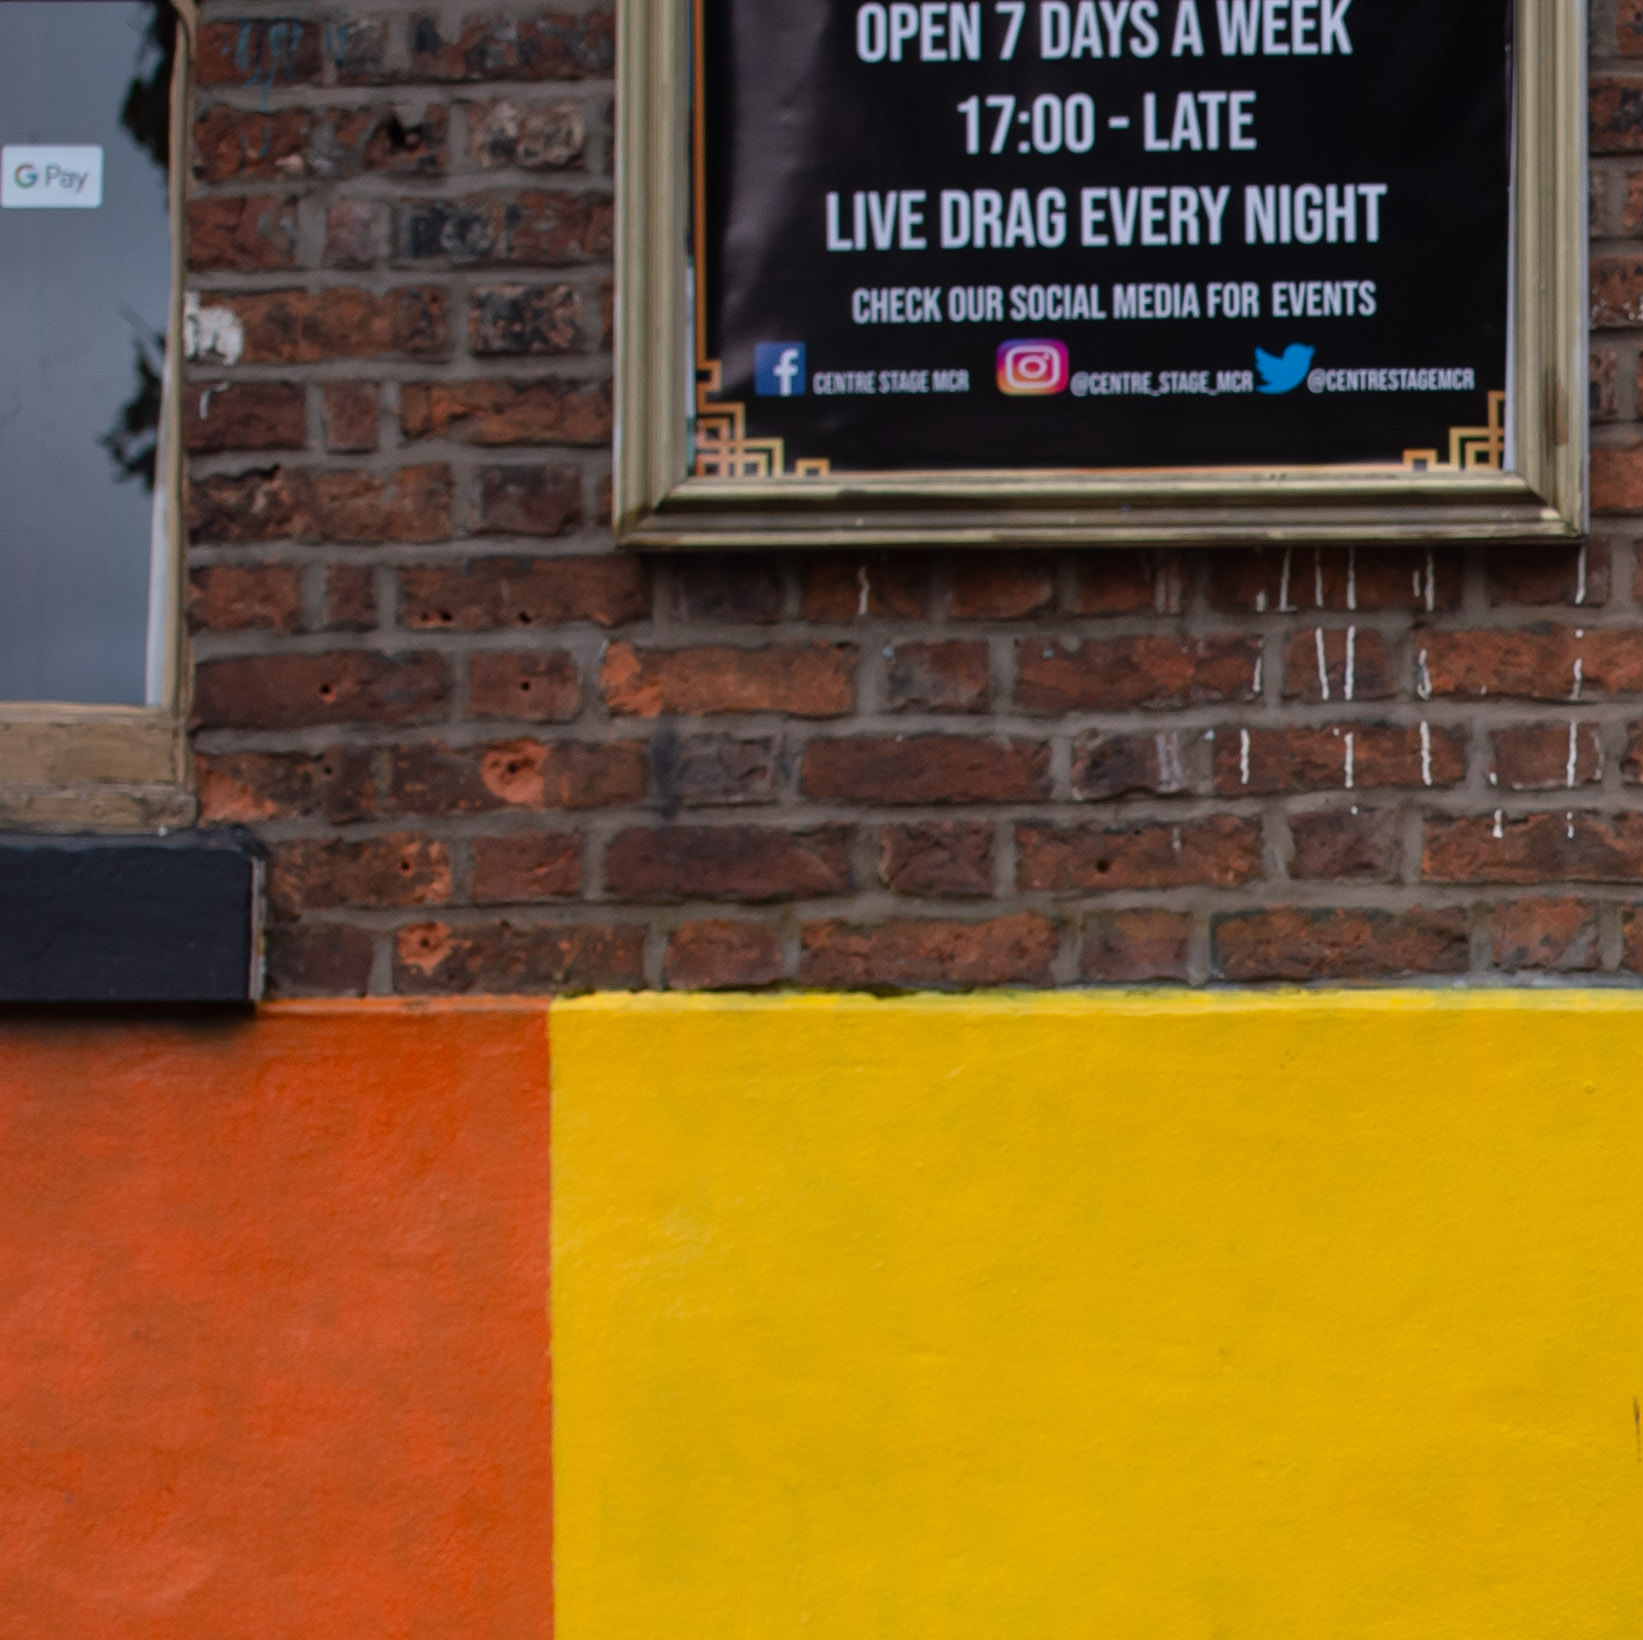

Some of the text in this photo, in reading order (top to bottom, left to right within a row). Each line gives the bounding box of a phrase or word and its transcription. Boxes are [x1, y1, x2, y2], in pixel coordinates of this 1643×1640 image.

[856, 0, 1353, 63] OPEN 7 DAYS A WEEK
[957, 93, 1095, 155] 17:00
[1143, 90, 1257, 151] LATE
[46, 163, 88, 193] Pay
[826, 183, 1388, 251] LIVE DRAG EVERY NIGHT
[852, 280, 1377, 324] CHECK OUR SOCIAL MEDIA FOR EVENTS
[812, 369, 970, 395] CENTRE STAGE MCR
[1070, 370, 1254, 397] @CENTRE_STAGE_MCR
[1306, 367, 1475, 393] @CENTRESTAGEMCR
